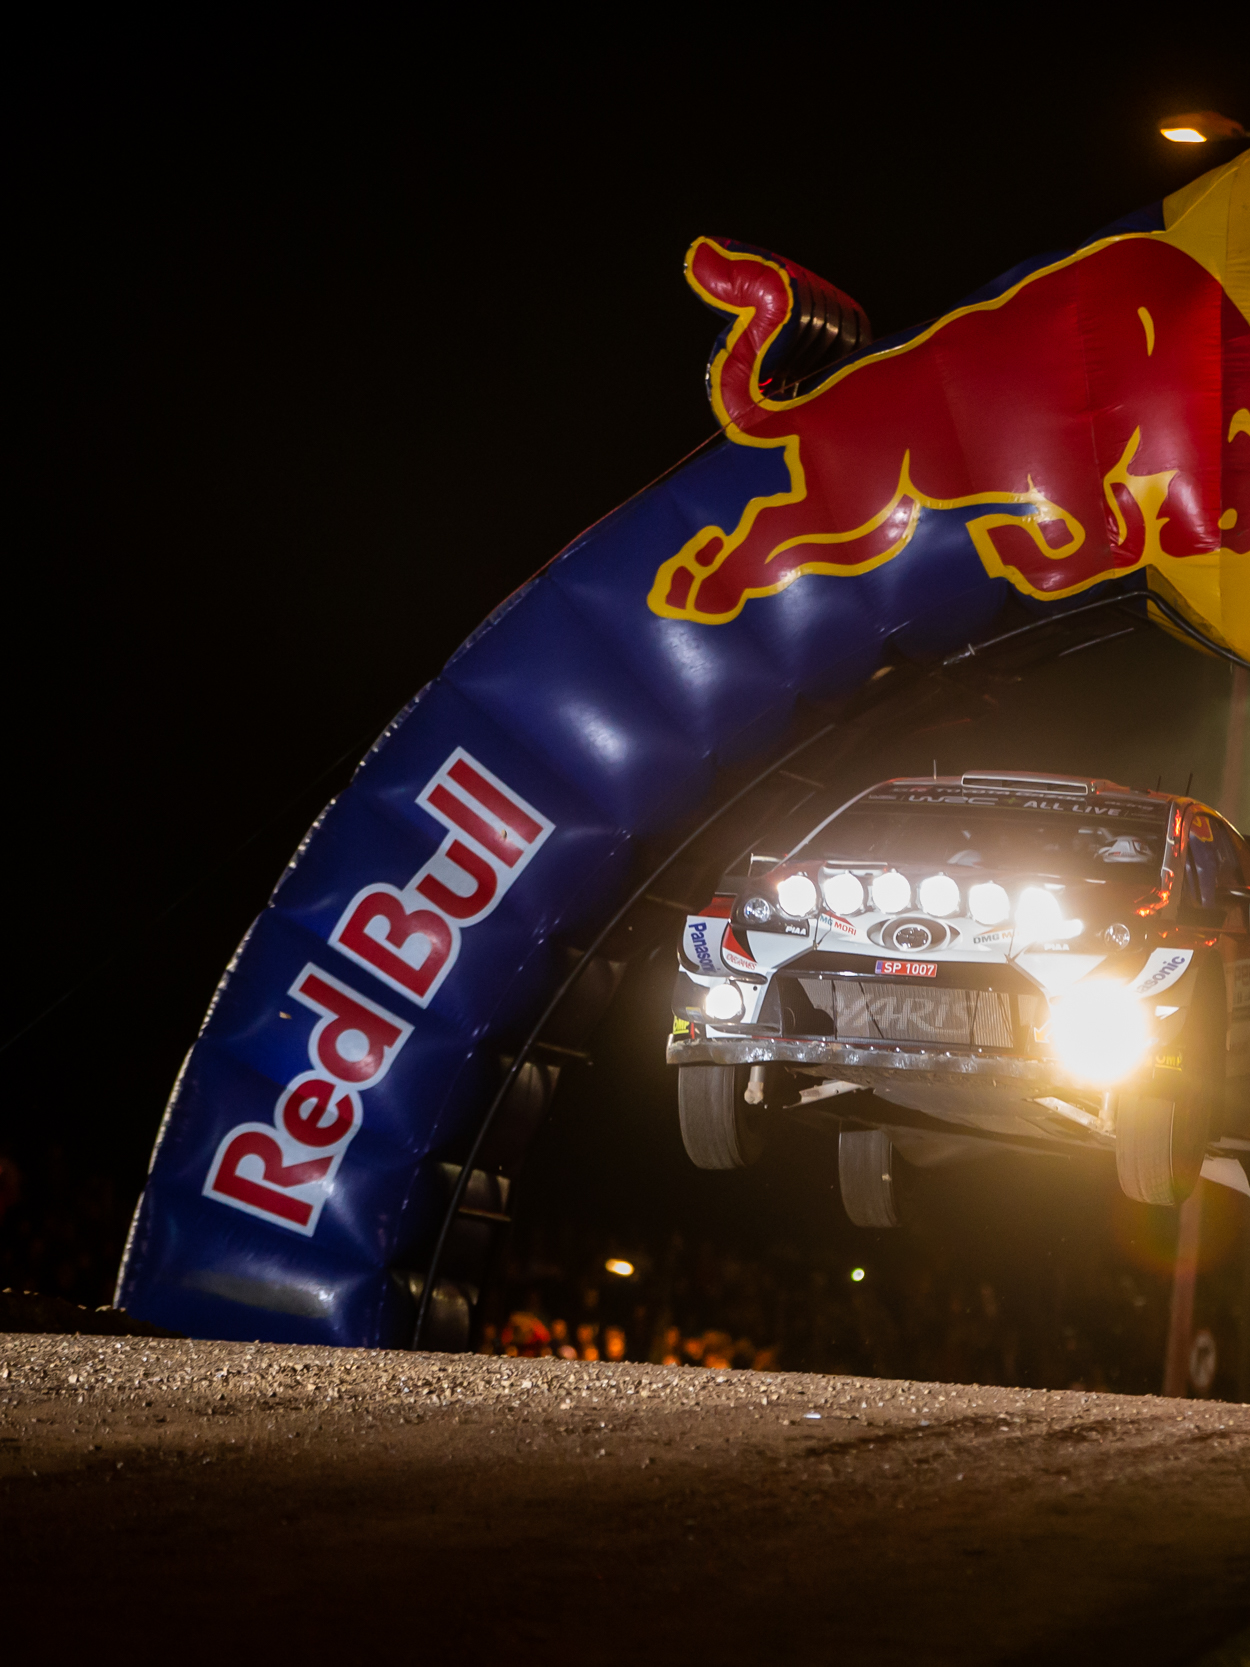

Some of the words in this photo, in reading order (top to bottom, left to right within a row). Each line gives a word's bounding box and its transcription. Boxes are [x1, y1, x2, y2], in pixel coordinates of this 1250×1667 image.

[1023, 800, 1064, 811] ALL
[1072, 804, 1122, 816] LIVE
[785, 925, 807, 935] PIAA
[834, 921, 857, 936] MORI
[973, 933, 1000, 944] DMG
[883, 962, 902, 973] SP
[905, 963, 935, 976] 1007
[206, 967, 408, 1231] Red
[334, 752, 550, 1004] Bull
